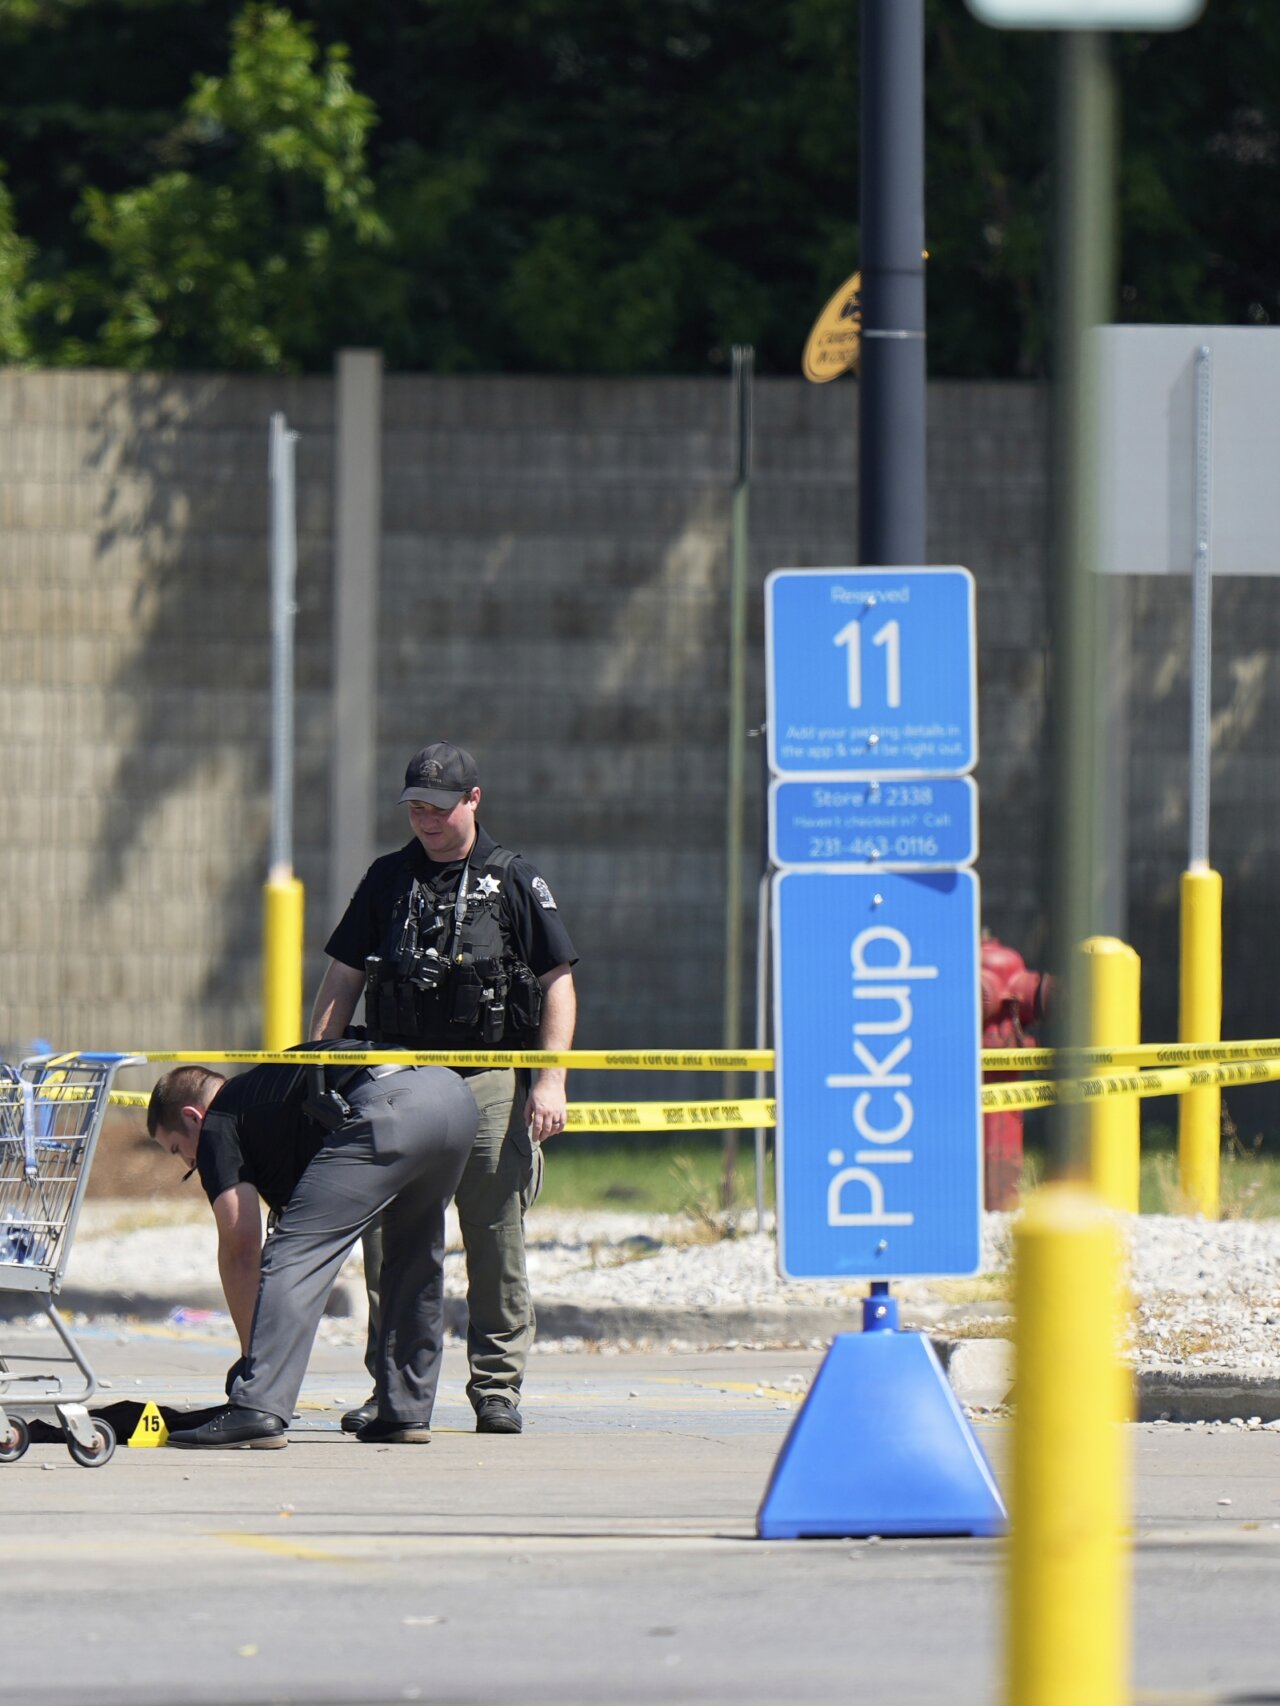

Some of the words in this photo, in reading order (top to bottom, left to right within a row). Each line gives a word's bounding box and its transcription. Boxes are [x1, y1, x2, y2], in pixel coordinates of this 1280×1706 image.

[830, 586, 910, 604] Reserved
[833, 619, 902, 709] 11
[812, 787, 865, 808] Store
[886, 786, 934, 806] 2338
[808, 834, 938, 858] 231-463-0116
[826, 925, 938, 1227] Pickup
[143, 1415, 160, 1432] 15
